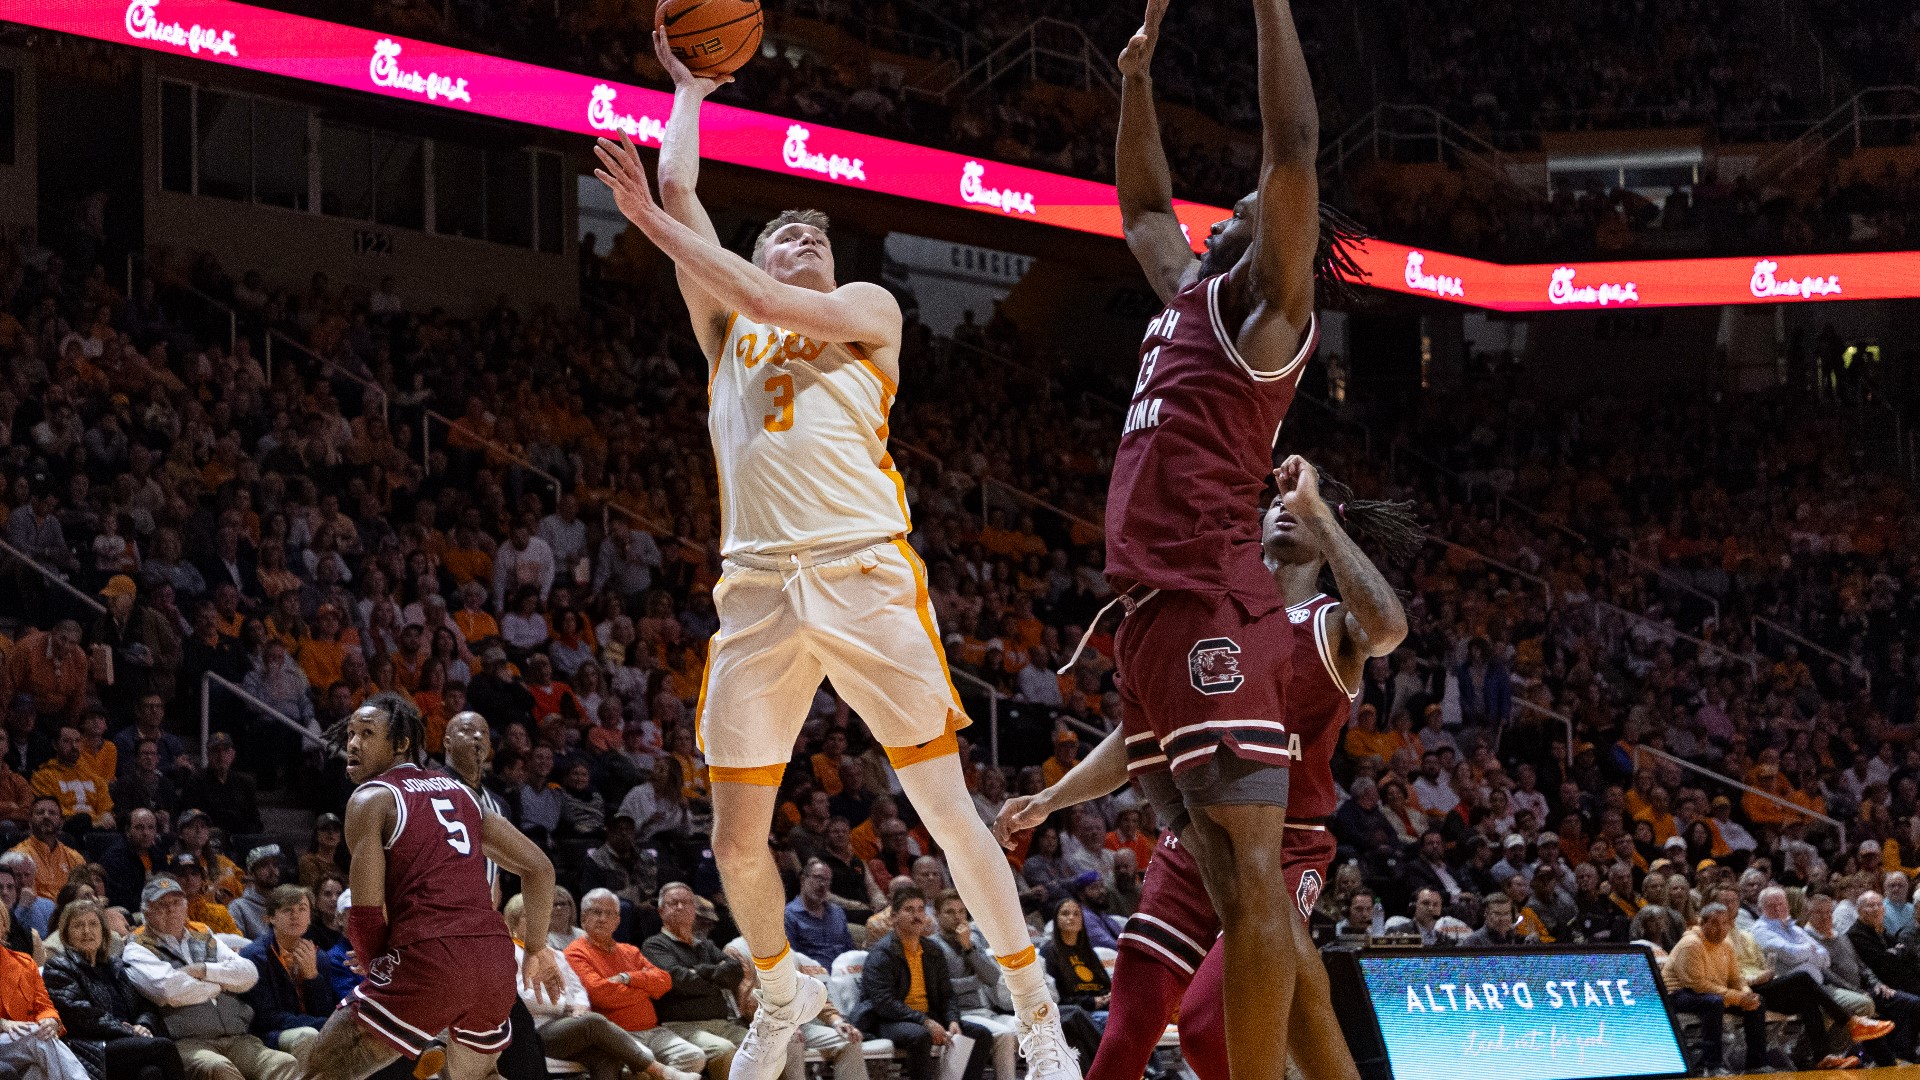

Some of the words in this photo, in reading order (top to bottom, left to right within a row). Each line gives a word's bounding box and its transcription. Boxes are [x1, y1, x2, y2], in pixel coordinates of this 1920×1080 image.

[370, 38, 471, 102] Chick-fil-A
[588, 83, 671, 142] Chick-fil-
[783, 124, 865, 181] Chick-fil-A
[960, 160, 1036, 215] Chick-fil-A
[1549, 266, 1639, 305] Chick-fil-A
[1750, 259, 1842, 299] Chick-fil-A
[764, 374, 794, 433] 3
[1121, 398, 1163, 437] LINA
[401, 776, 460, 792] JOHNSON
[430, 797, 471, 855] 5
[1545, 979, 1636, 1008] STATE
